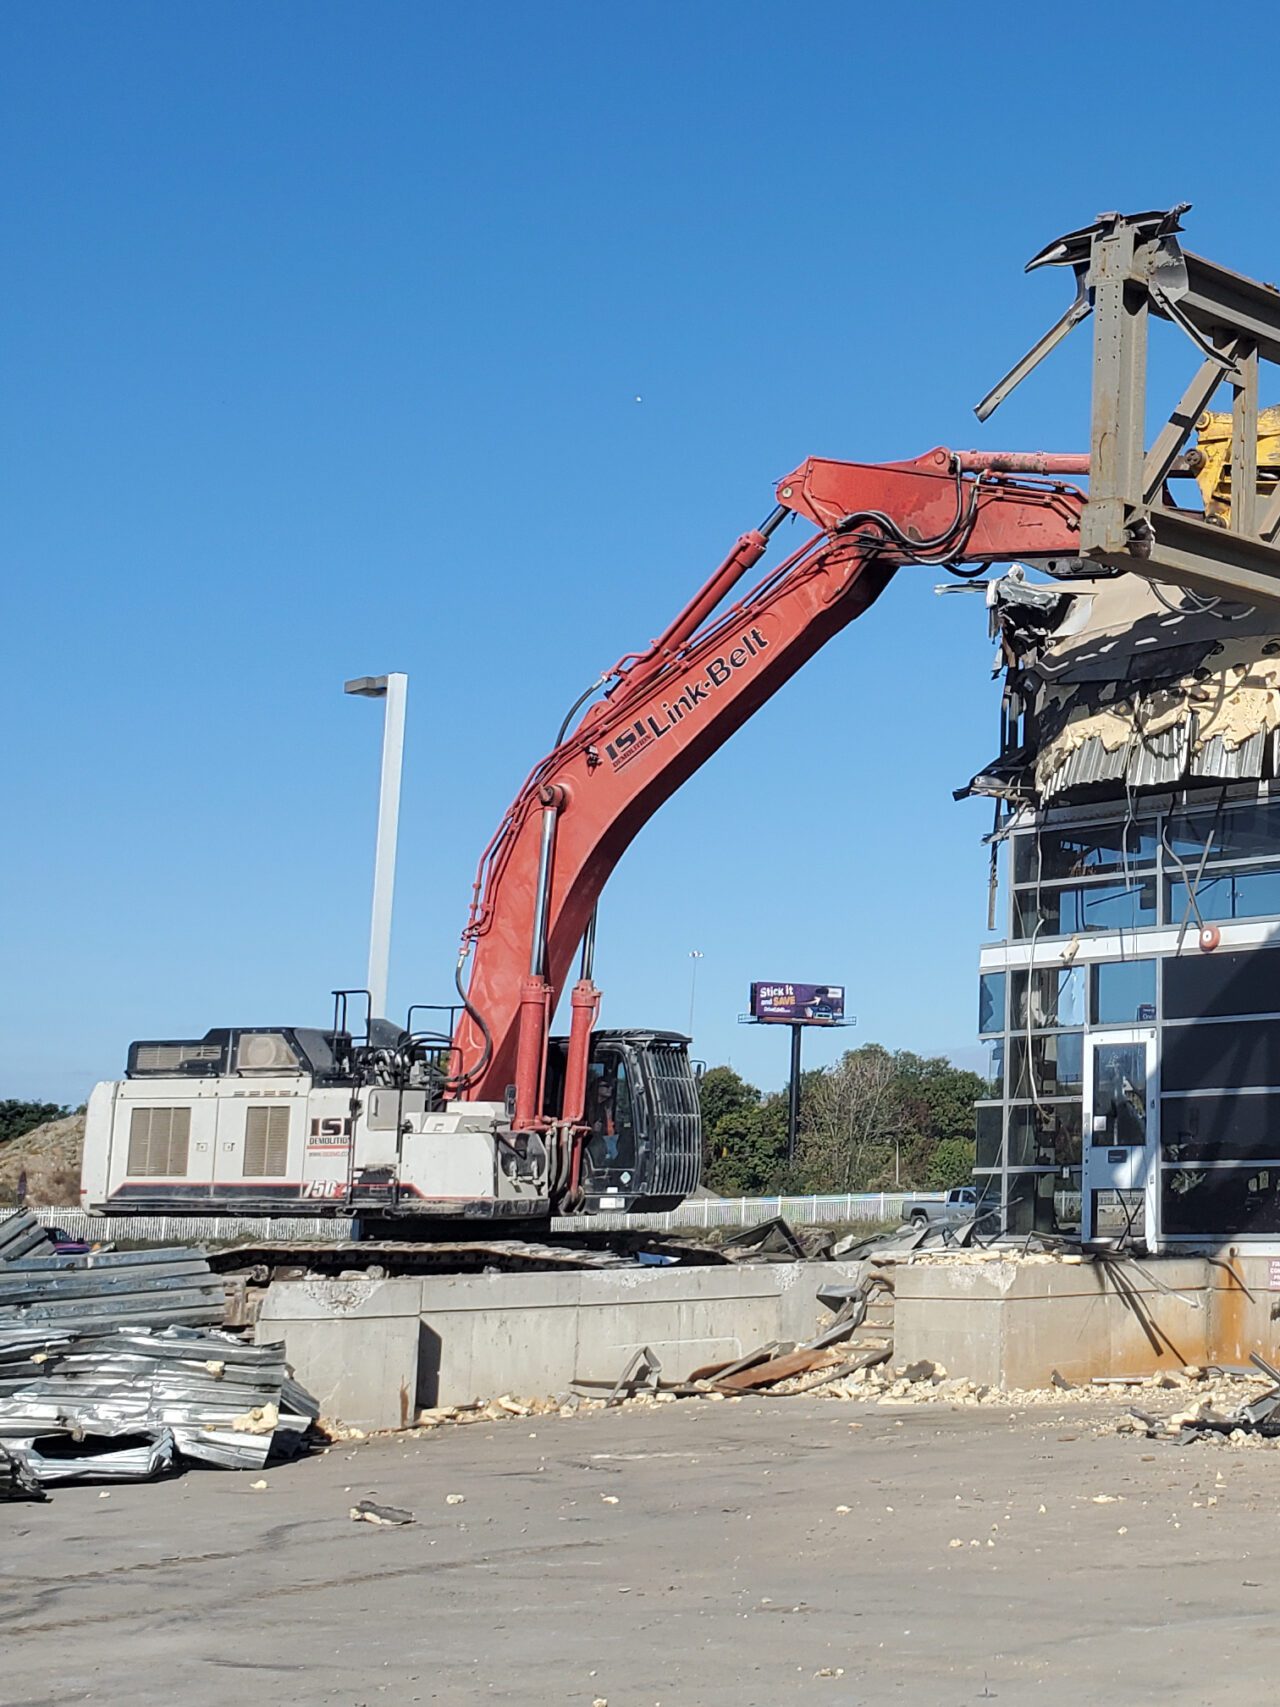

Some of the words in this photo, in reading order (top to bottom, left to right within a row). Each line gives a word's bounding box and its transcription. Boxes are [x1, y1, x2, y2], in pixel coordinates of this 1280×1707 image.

[647, 629, 768, 738] Link-Belt
[605, 720, 647, 760] ISI
[612, 735, 652, 767] DEMOLITION
[760, 986, 784, 998] Stick
[773, 996, 796, 1007] SAVE
